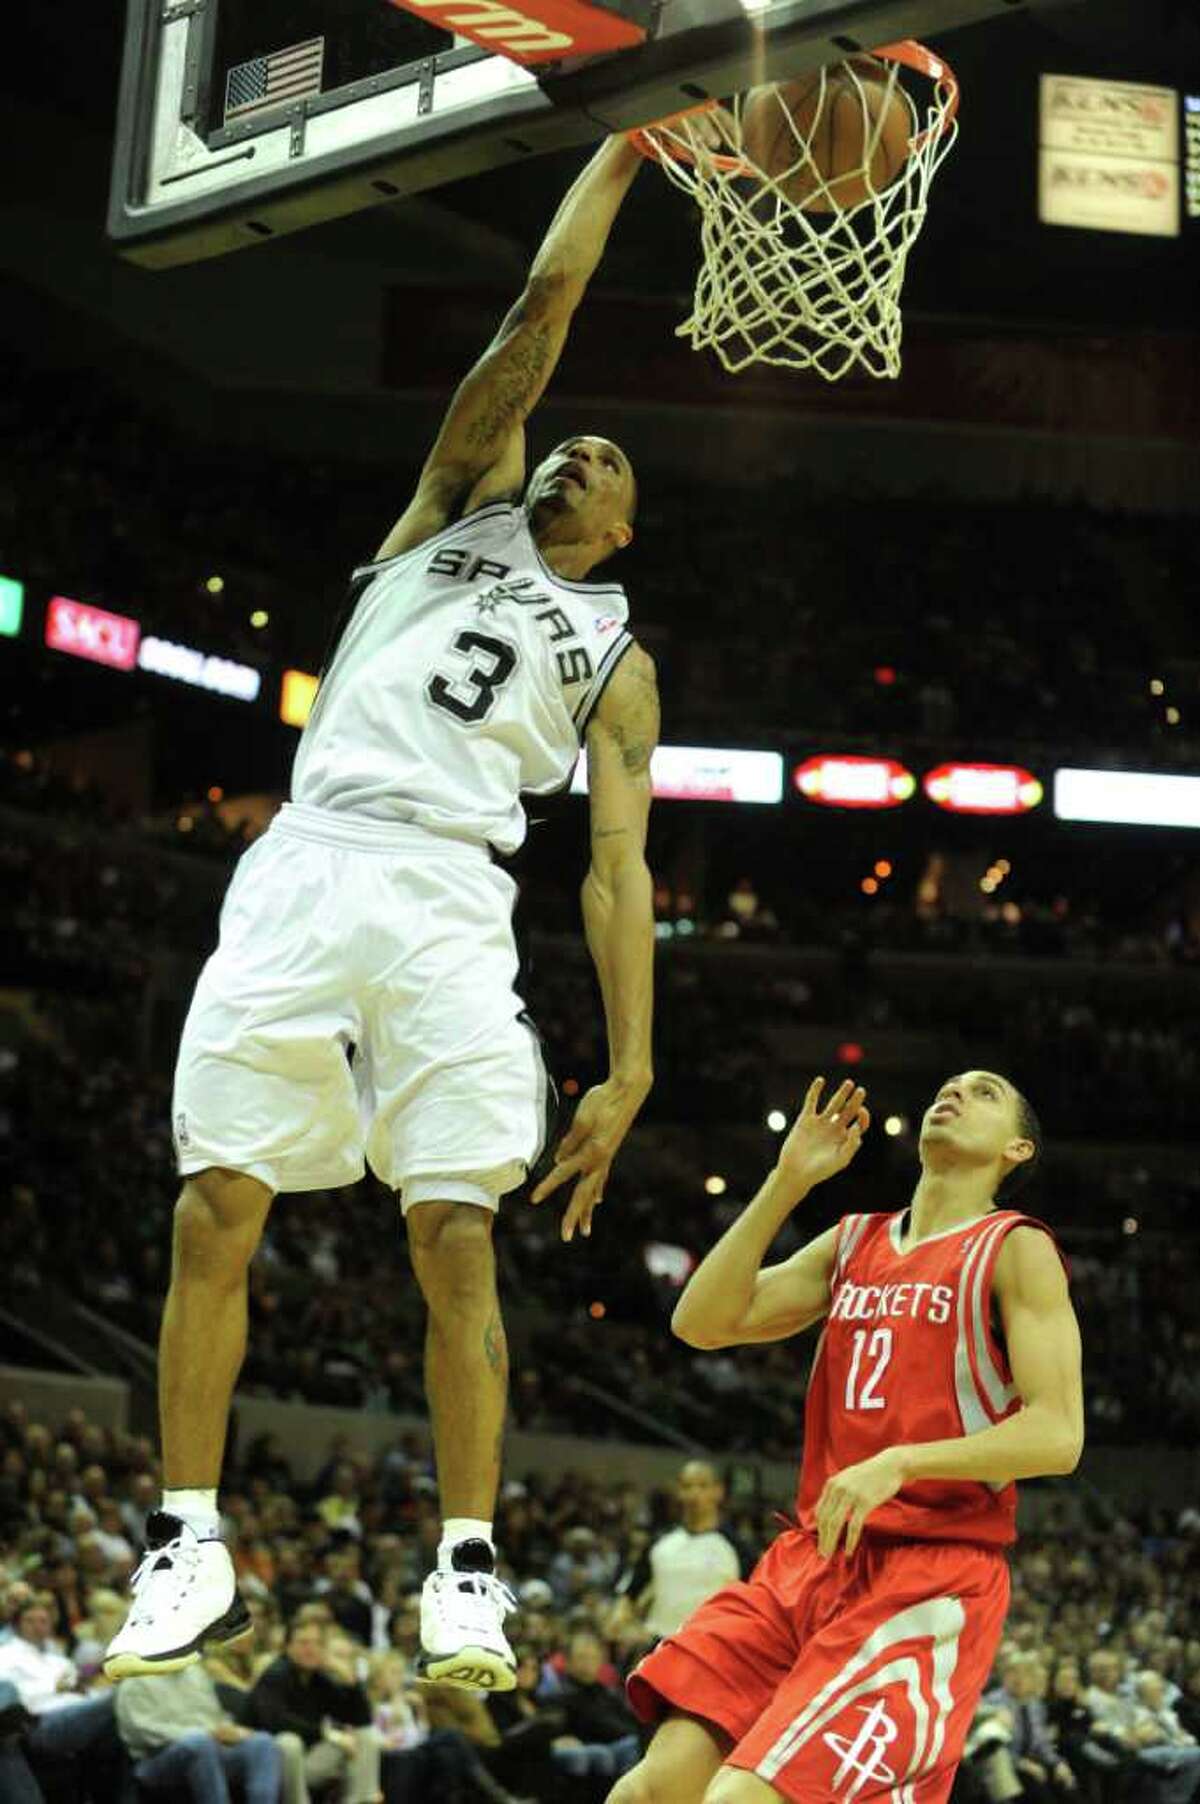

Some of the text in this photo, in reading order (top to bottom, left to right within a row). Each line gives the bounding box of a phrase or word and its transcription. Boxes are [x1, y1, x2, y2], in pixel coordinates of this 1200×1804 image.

[426, 549, 594, 686] SPURS
[425, 628, 519, 725] 3
[830, 1280, 954, 1325] ROCKETS
[844, 1328, 893, 1410] 12
